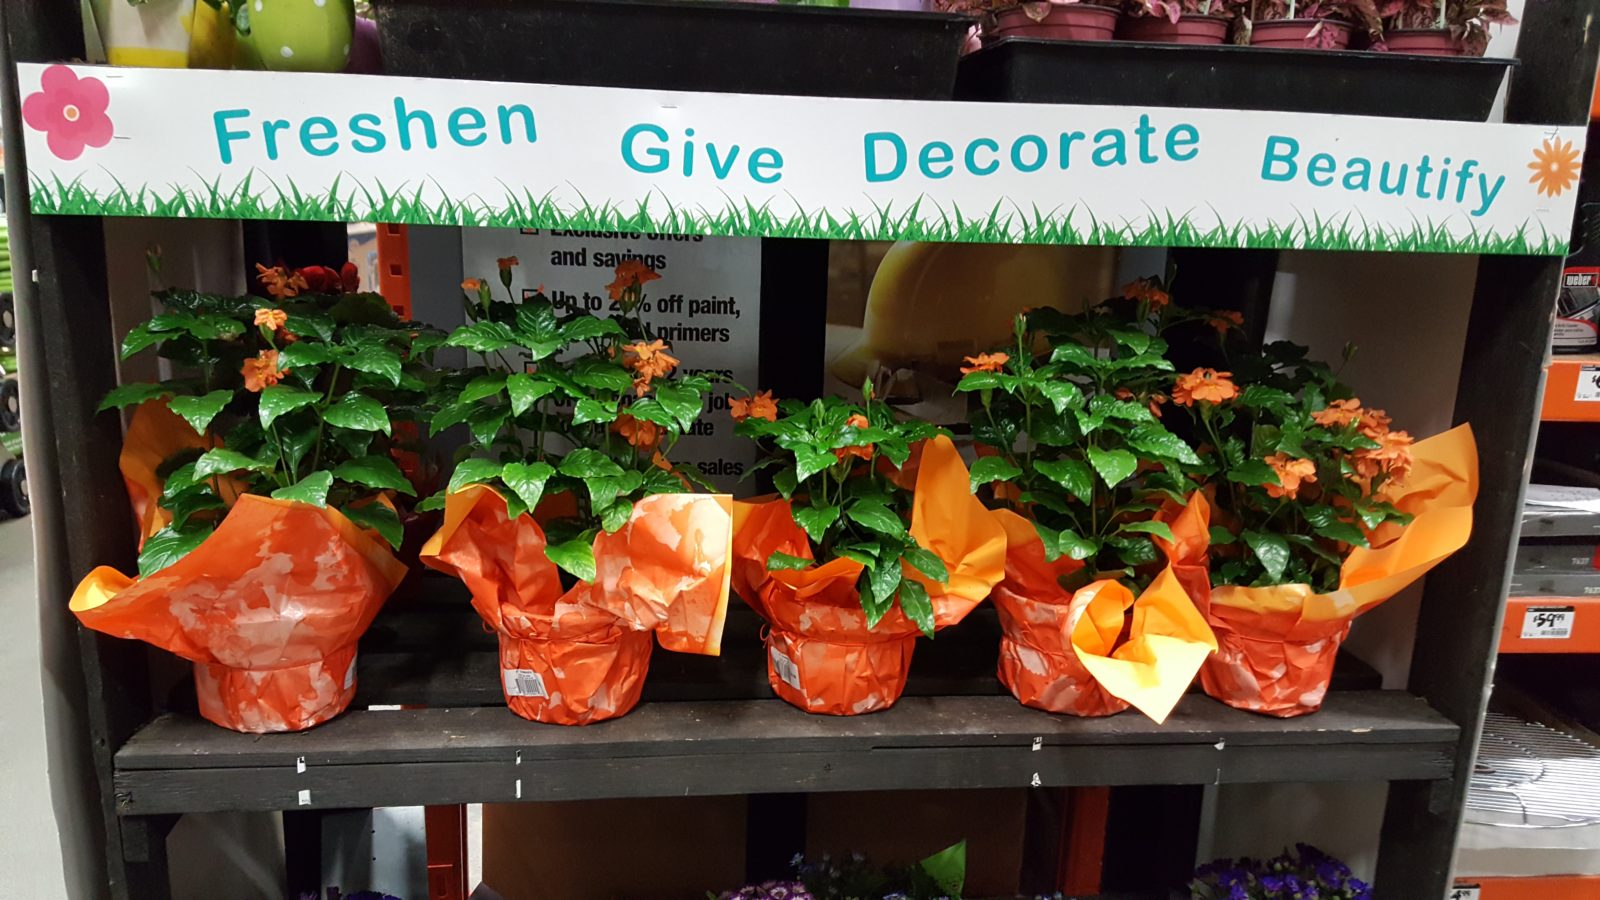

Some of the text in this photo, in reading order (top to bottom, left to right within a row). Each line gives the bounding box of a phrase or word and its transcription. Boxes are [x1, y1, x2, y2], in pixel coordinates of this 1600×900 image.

[213, 96, 1506, 217] Freshen Give Decorate Beautify
[551, 248, 666, 271] and savings
[1566, 273, 1591, 285] weber
[551, 290, 741, 318] Up to 2% off paint,
[657, 323, 731, 342] primers
[697, 458, 744, 476] sales
